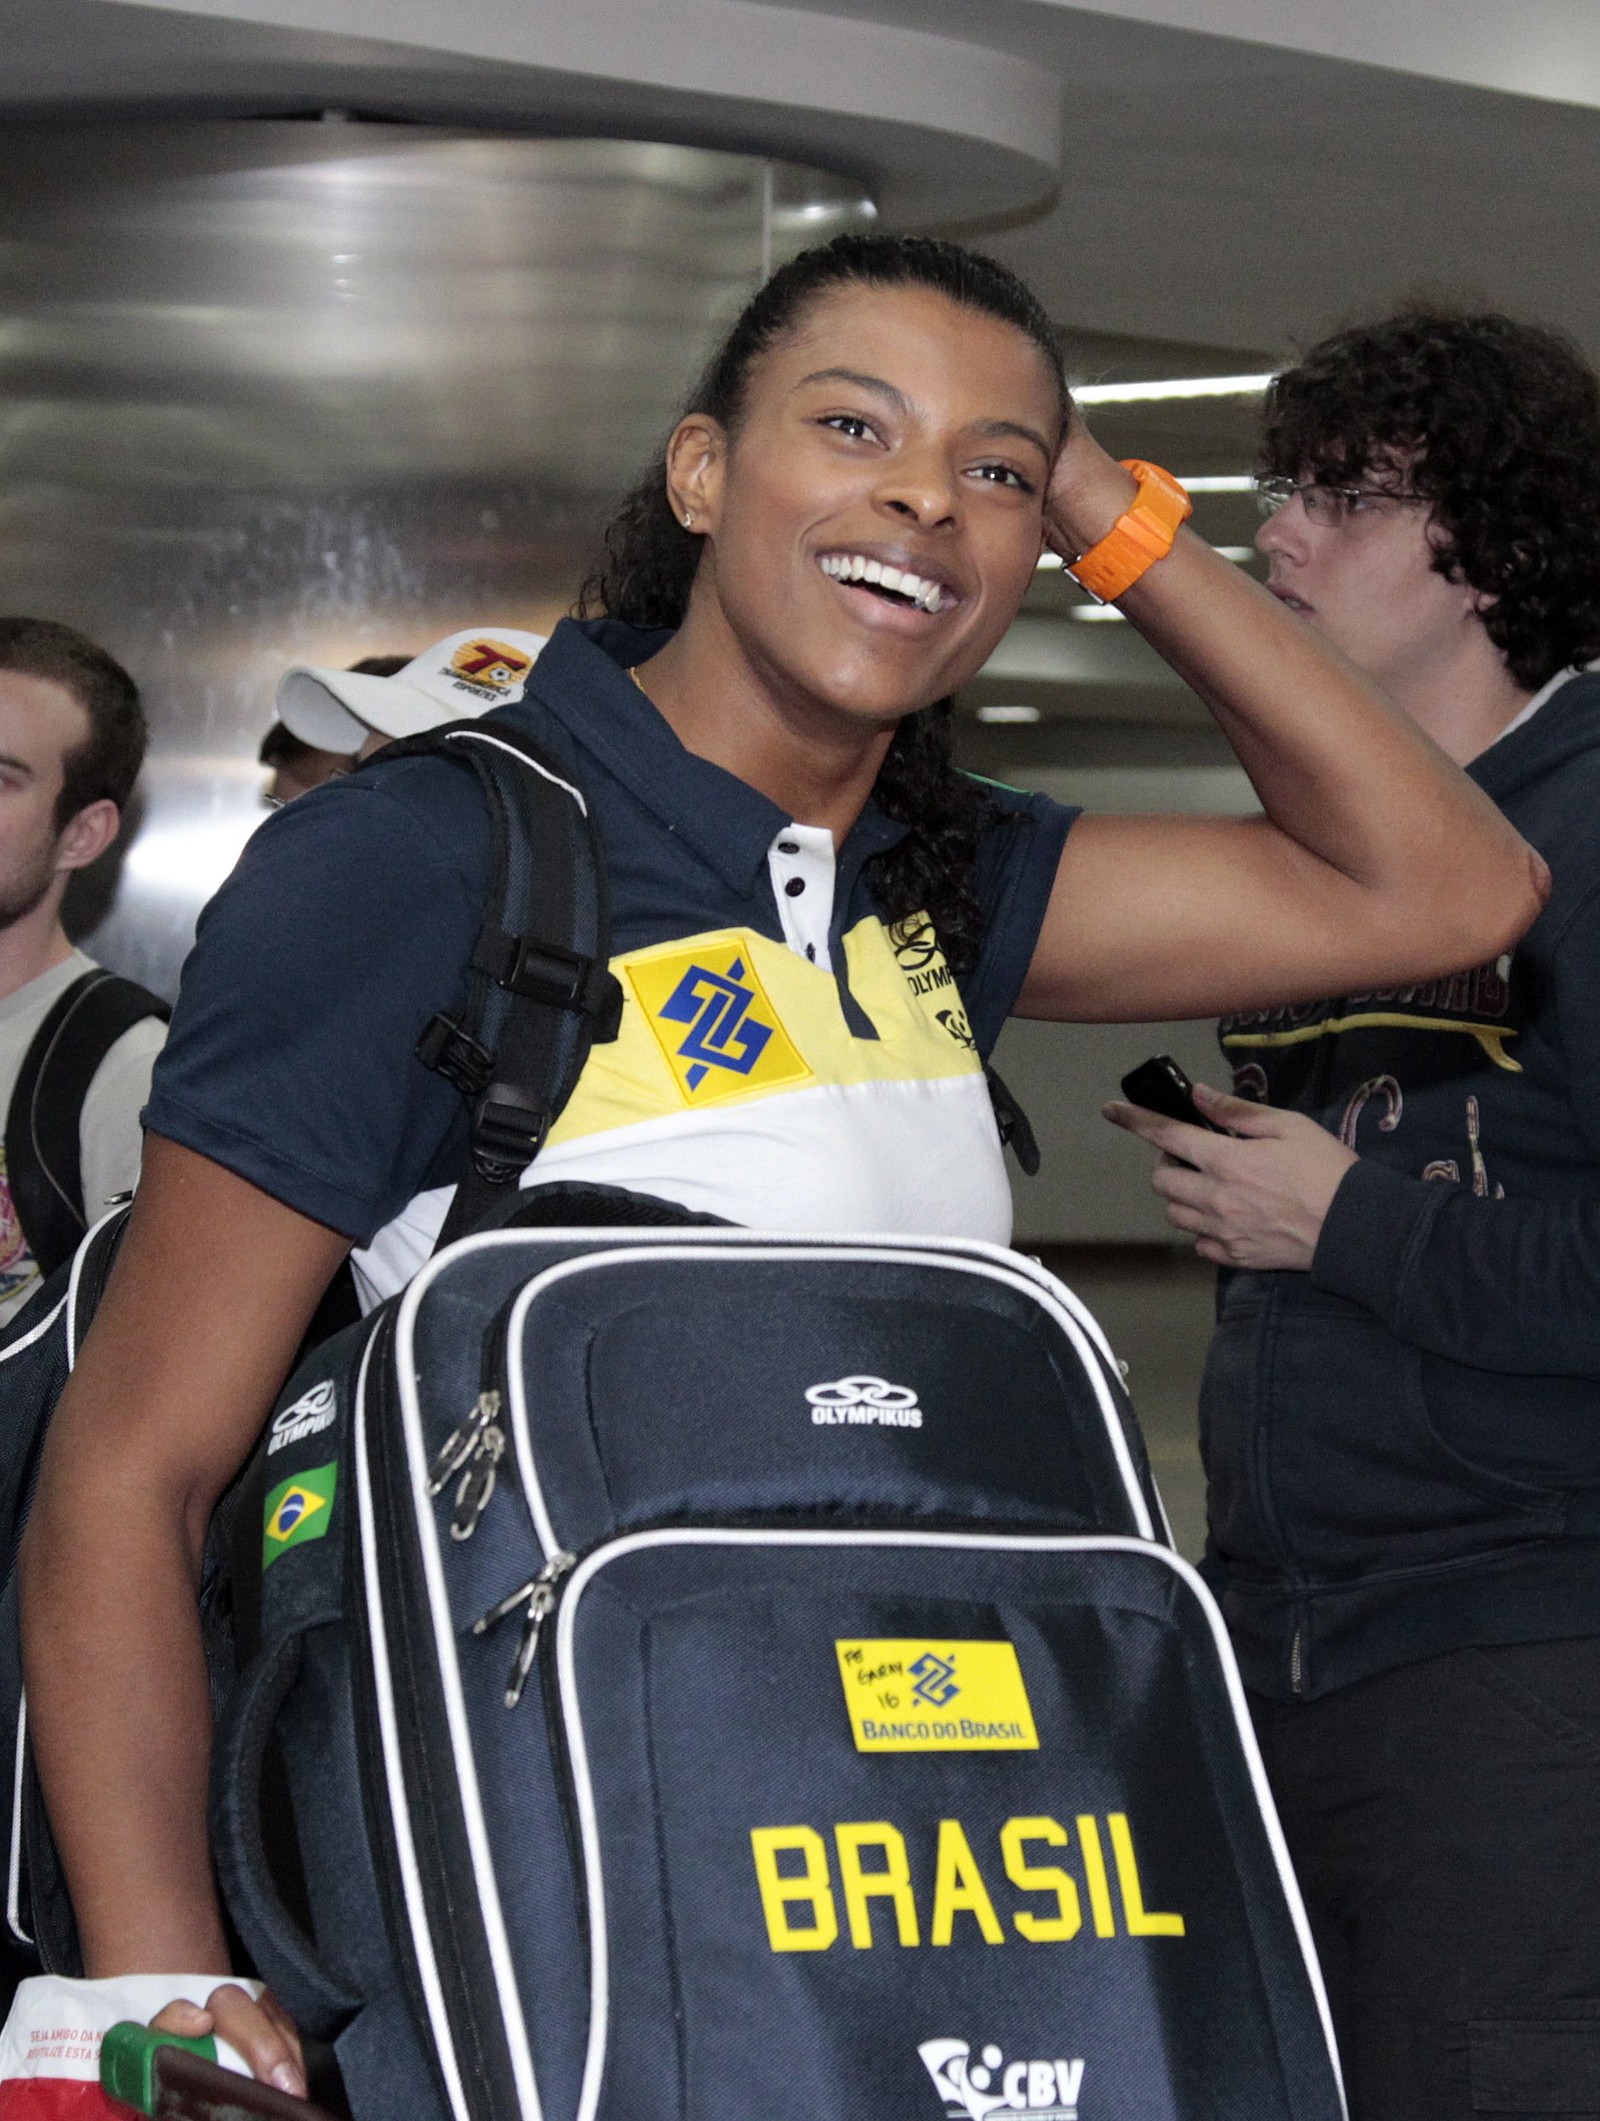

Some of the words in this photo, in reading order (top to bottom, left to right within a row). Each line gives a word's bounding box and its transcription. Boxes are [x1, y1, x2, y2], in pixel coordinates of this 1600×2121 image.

[811, 1405, 923, 1428] OLYMPIKUS
[877, 1692, 900, 1709] 16
[862, 1720, 929, 1740] BANCO
[933, 1722, 958, 1739] DO
[959, 1719, 1023, 1739] BRASIL
[750, 1812, 1186, 1952] BRASIL
[50, 2028, 78, 2041] AMIGO
[65, 2047, 92, 2060] ESTA
[1003, 2058, 1085, 2109] CBV
